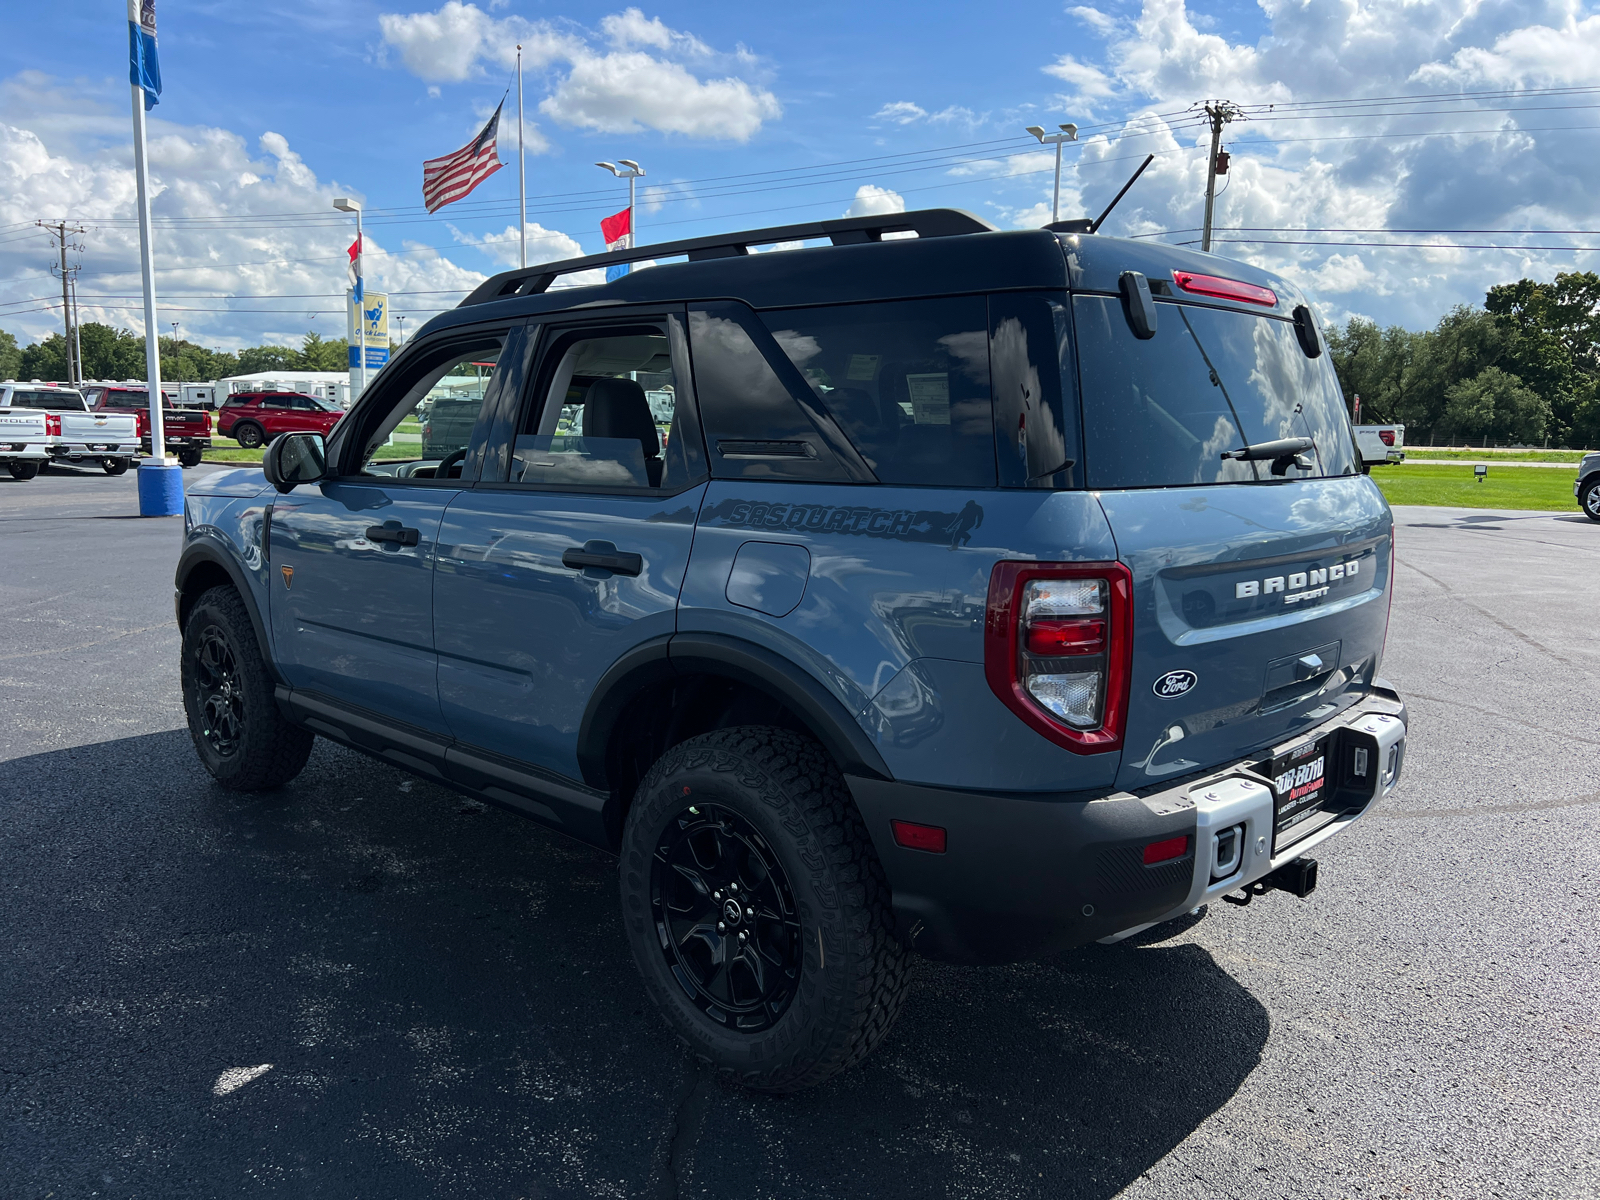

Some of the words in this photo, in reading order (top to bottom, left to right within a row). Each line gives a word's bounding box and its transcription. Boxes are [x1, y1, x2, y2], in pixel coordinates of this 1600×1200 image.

[729, 504, 915, 534] SASQUATCH
[1235, 560, 1359, 599] BRONCO
[1284, 586, 1330, 605] SPORT
[1162, 674, 1191, 694] Ford
